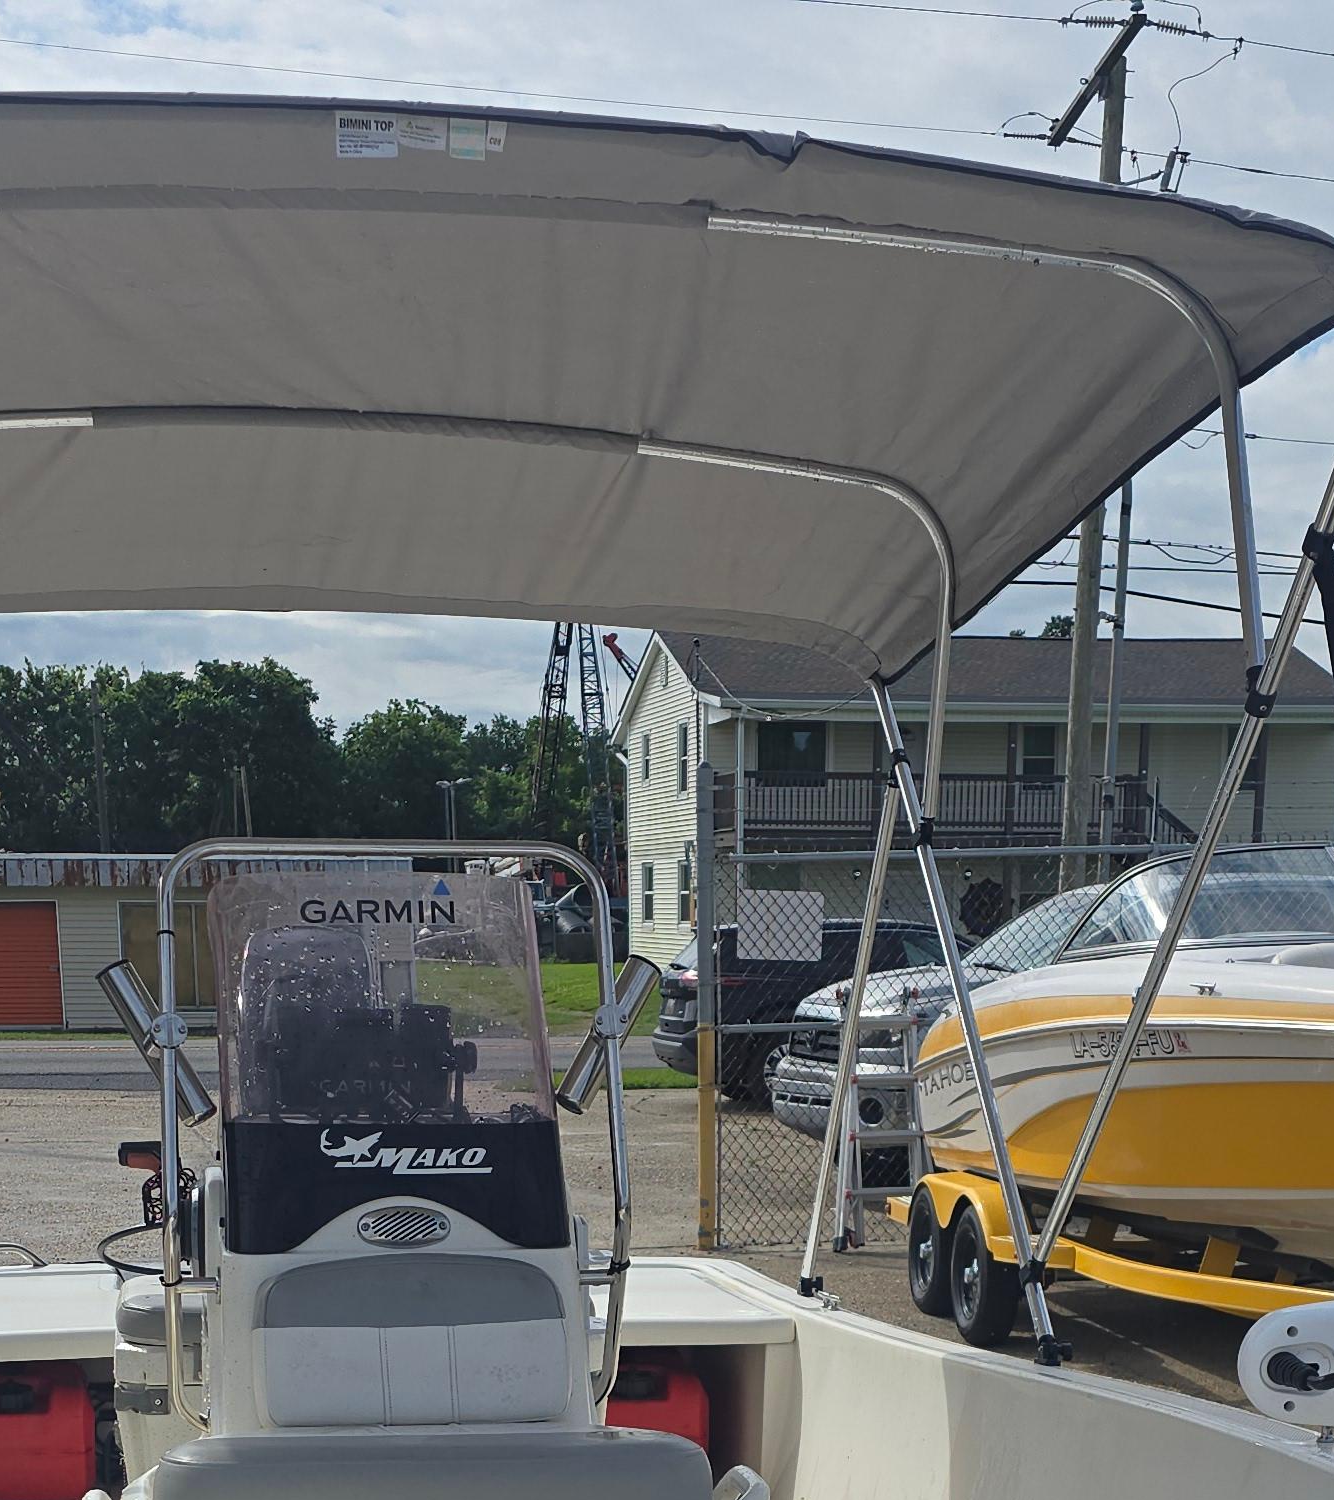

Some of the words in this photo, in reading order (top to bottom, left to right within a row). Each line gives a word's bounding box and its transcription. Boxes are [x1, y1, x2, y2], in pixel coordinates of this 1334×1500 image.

[339, 117, 372, 131] BIMINI
[373, 119, 394, 132] TOP
[299, 899, 456, 924] GARMIN
[918, 1061, 975, 1096] TAHOE
[355, 1147, 494, 1175] MAKO
